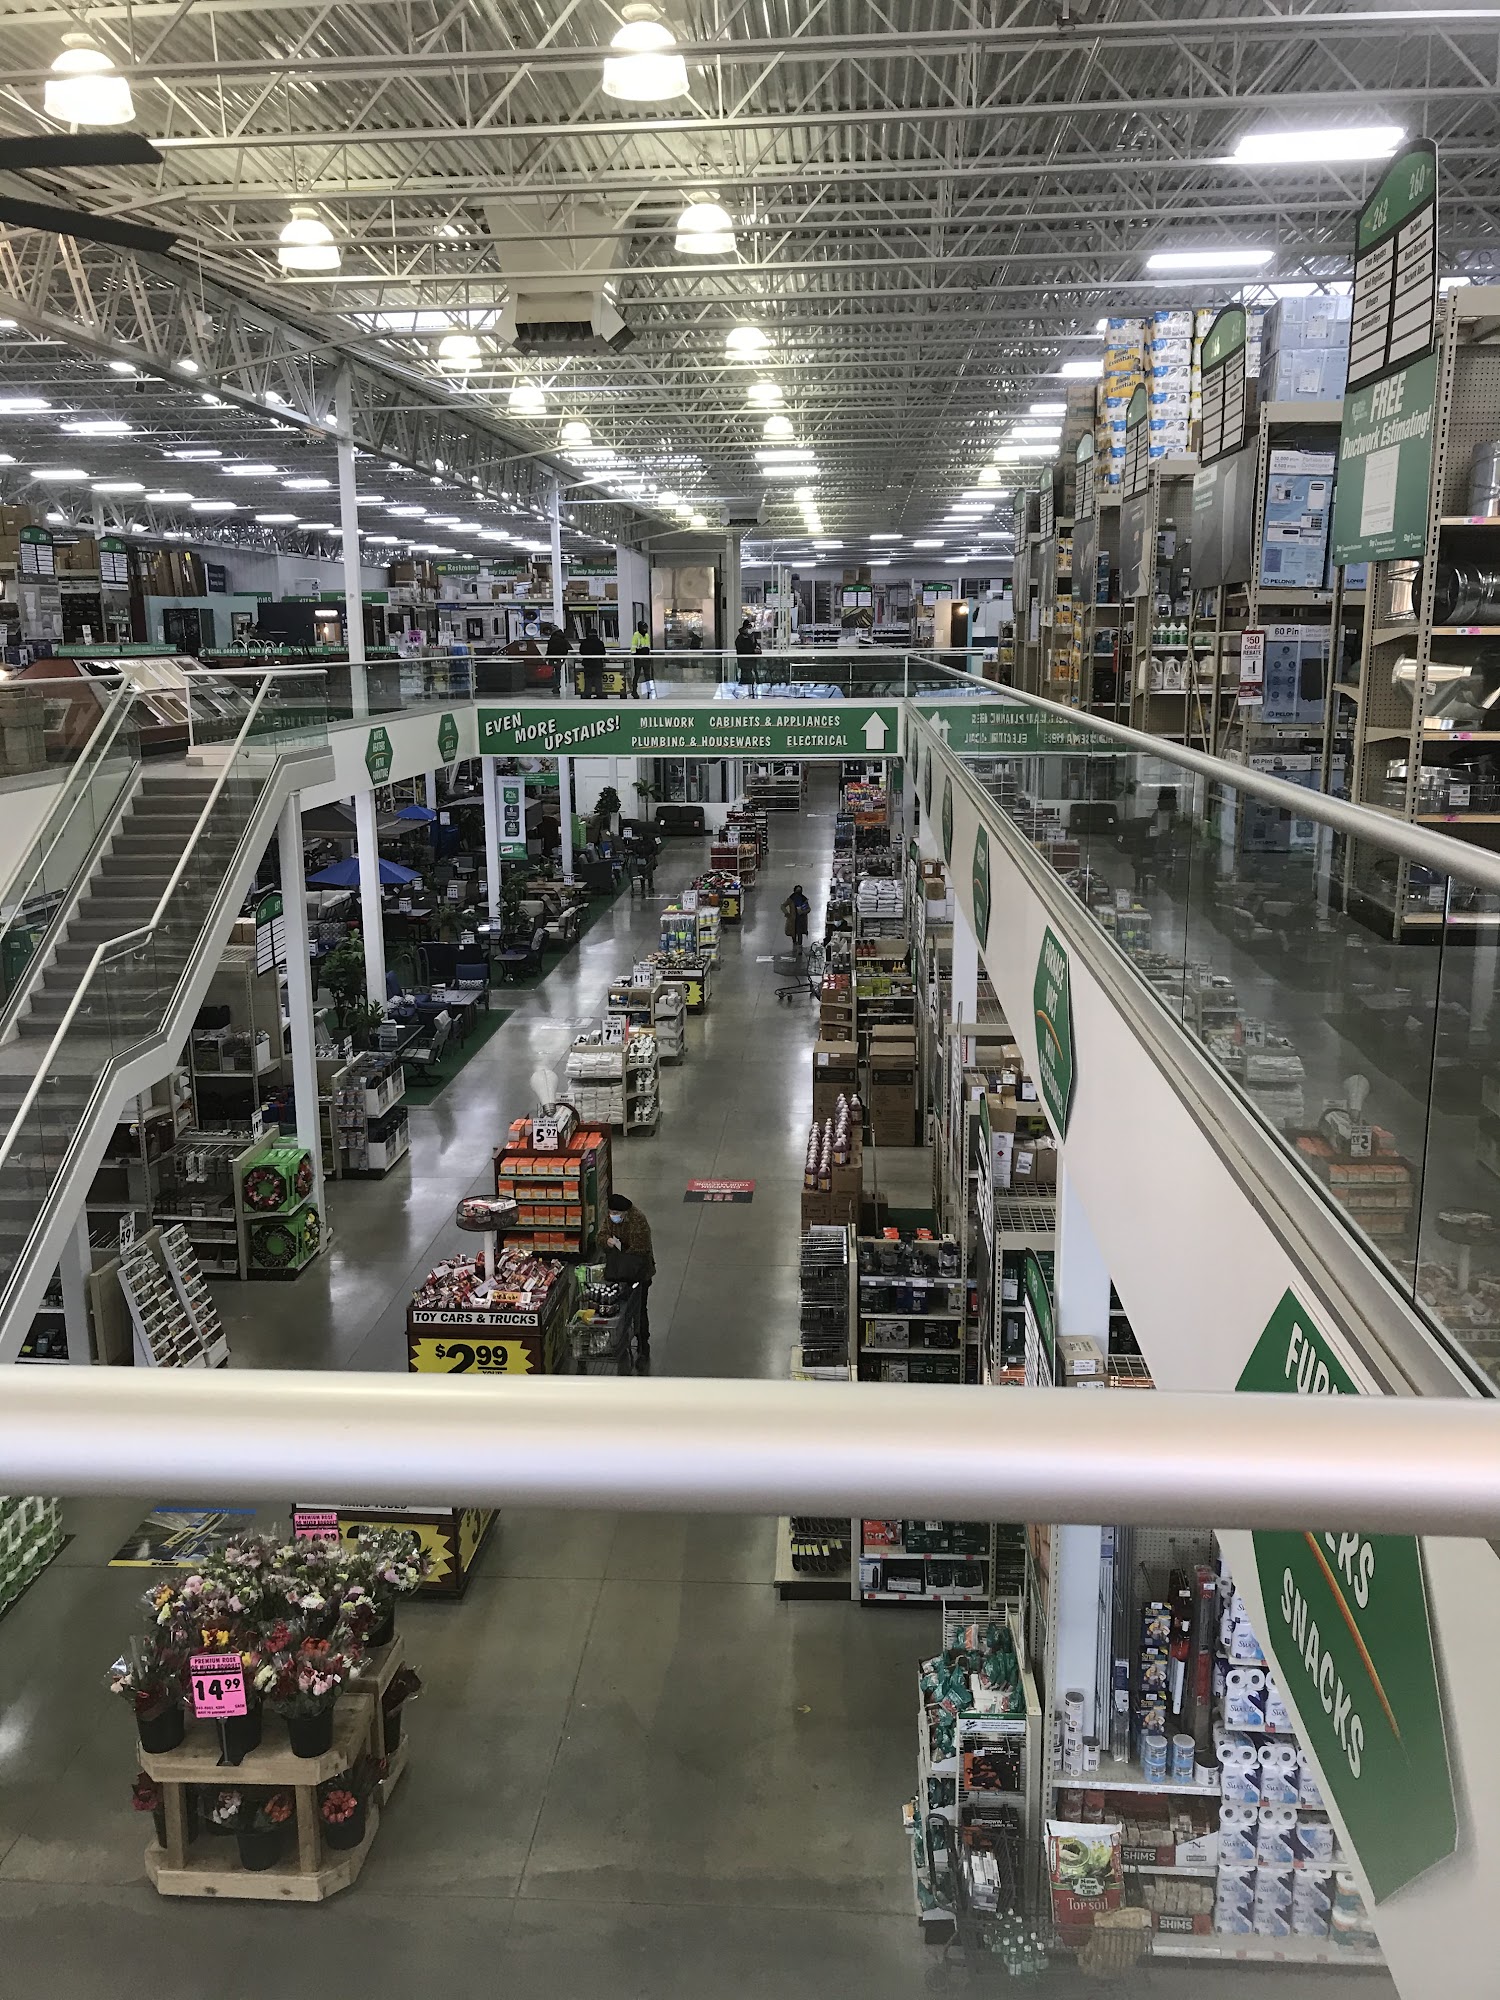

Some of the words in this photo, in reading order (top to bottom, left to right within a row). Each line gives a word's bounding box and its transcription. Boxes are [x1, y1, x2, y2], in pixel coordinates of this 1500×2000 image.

[1370, 371, 1407, 423] FREE
[1342, 425, 1380, 460] Ductwork
[1380, 404, 1432, 447] Estimating!
[485, 712, 522, 736] EVEN
[515, 718, 557, 743] MORE
[640, 716, 695, 728] MILLWORK
[709, 716, 760, 727] CABINETS
[765, 716, 772, 726] &
[776, 715, 840, 727] APPLIANCES
[544, 715, 620, 750] UPSTAIRS!
[631, 736, 686, 747] PLUMBING
[690, 736, 697, 747] &
[701, 736, 771, 747] HOUSEWARES
[786, 735, 848, 746] ELECTRICAL
[605, 1029, 612, 1040] 7
[536, 1129, 545, 1142] 5
[415, 1312, 438, 1321] TOY
[440, 1313, 473, 1322] CARS
[477, 1314, 485, 1323] &
[489, 1314, 536, 1324] TRUCKS
[476, 1345, 508, 1366] 99
[1281, 1567, 1364, 1780] SNACKS
[195, 1680, 223, 1700] 14
[225, 1678, 240, 1689] 99
[1123, 1851, 1156, 1861] SHIMS
[1160, 1920, 1193, 1930] SHIMS
